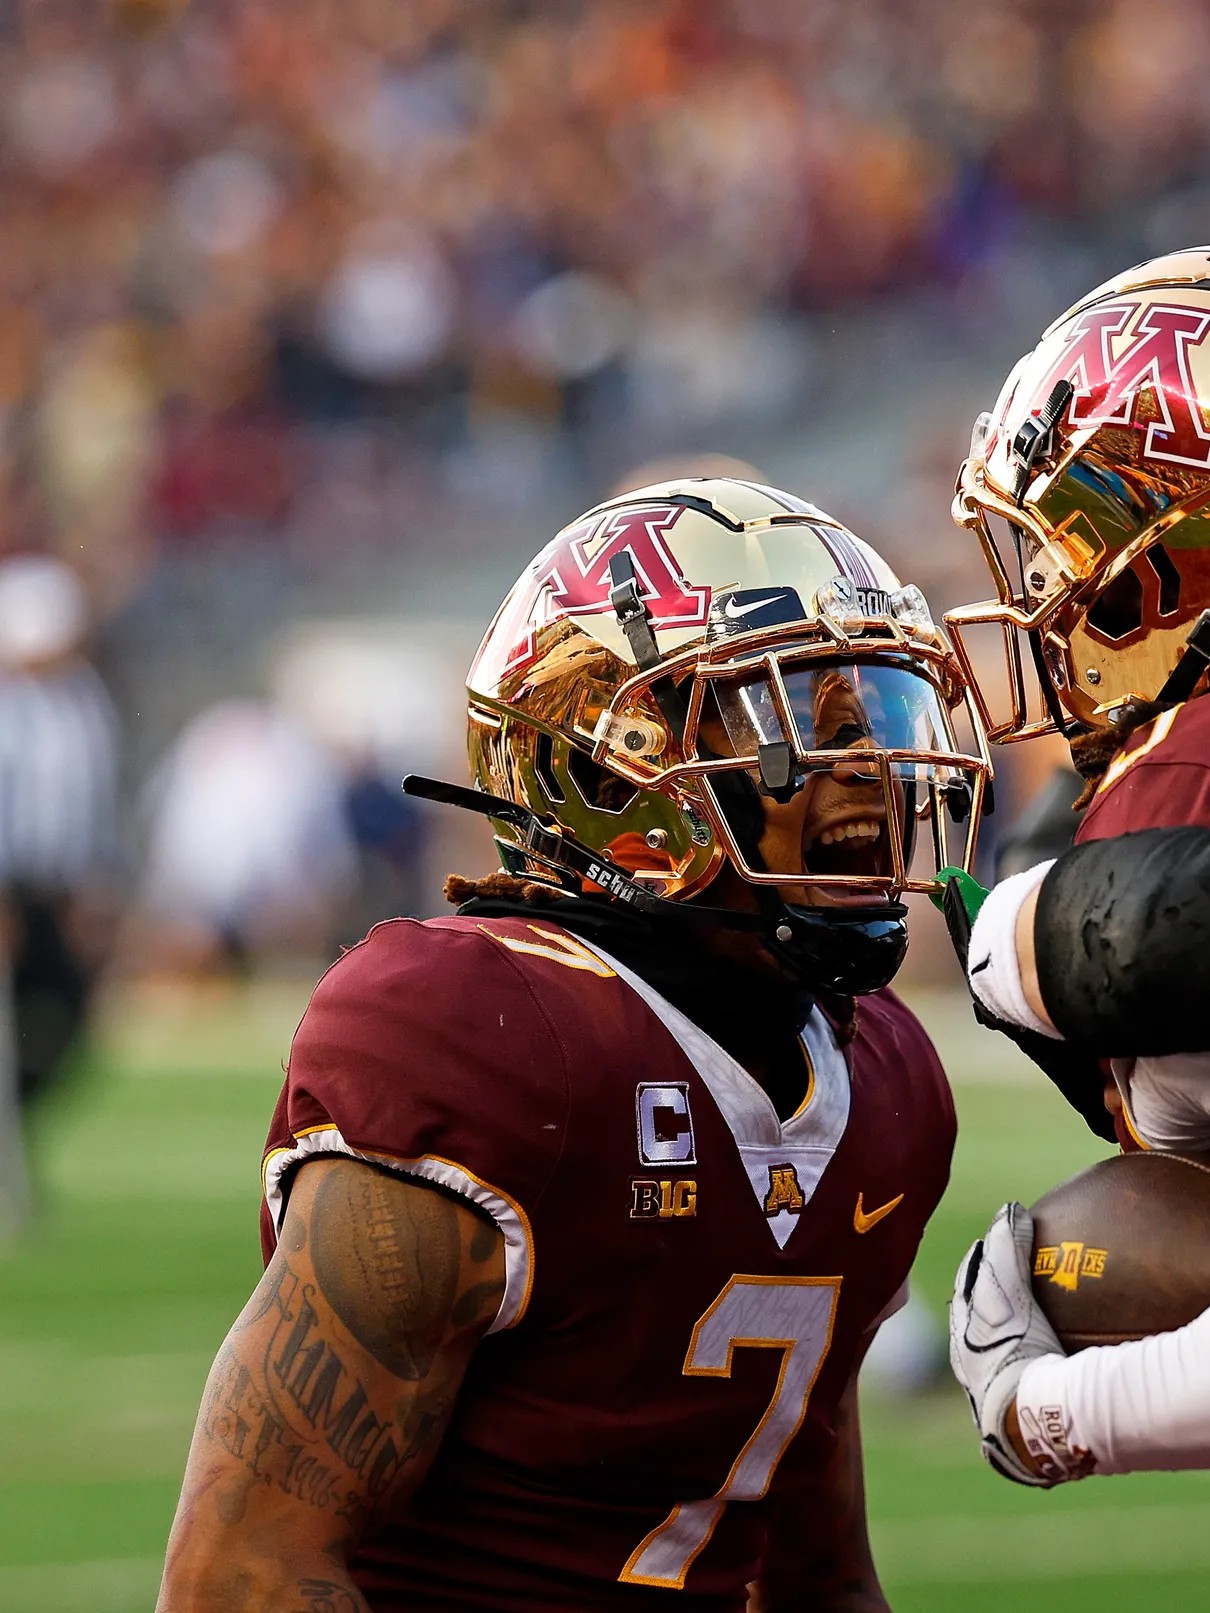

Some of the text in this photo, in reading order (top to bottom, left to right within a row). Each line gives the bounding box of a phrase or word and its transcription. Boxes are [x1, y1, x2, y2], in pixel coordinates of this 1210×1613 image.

[640, 1088, 692, 1161] C
[765, 1166, 804, 1214] M
[618, 1273, 843, 1590] 7
